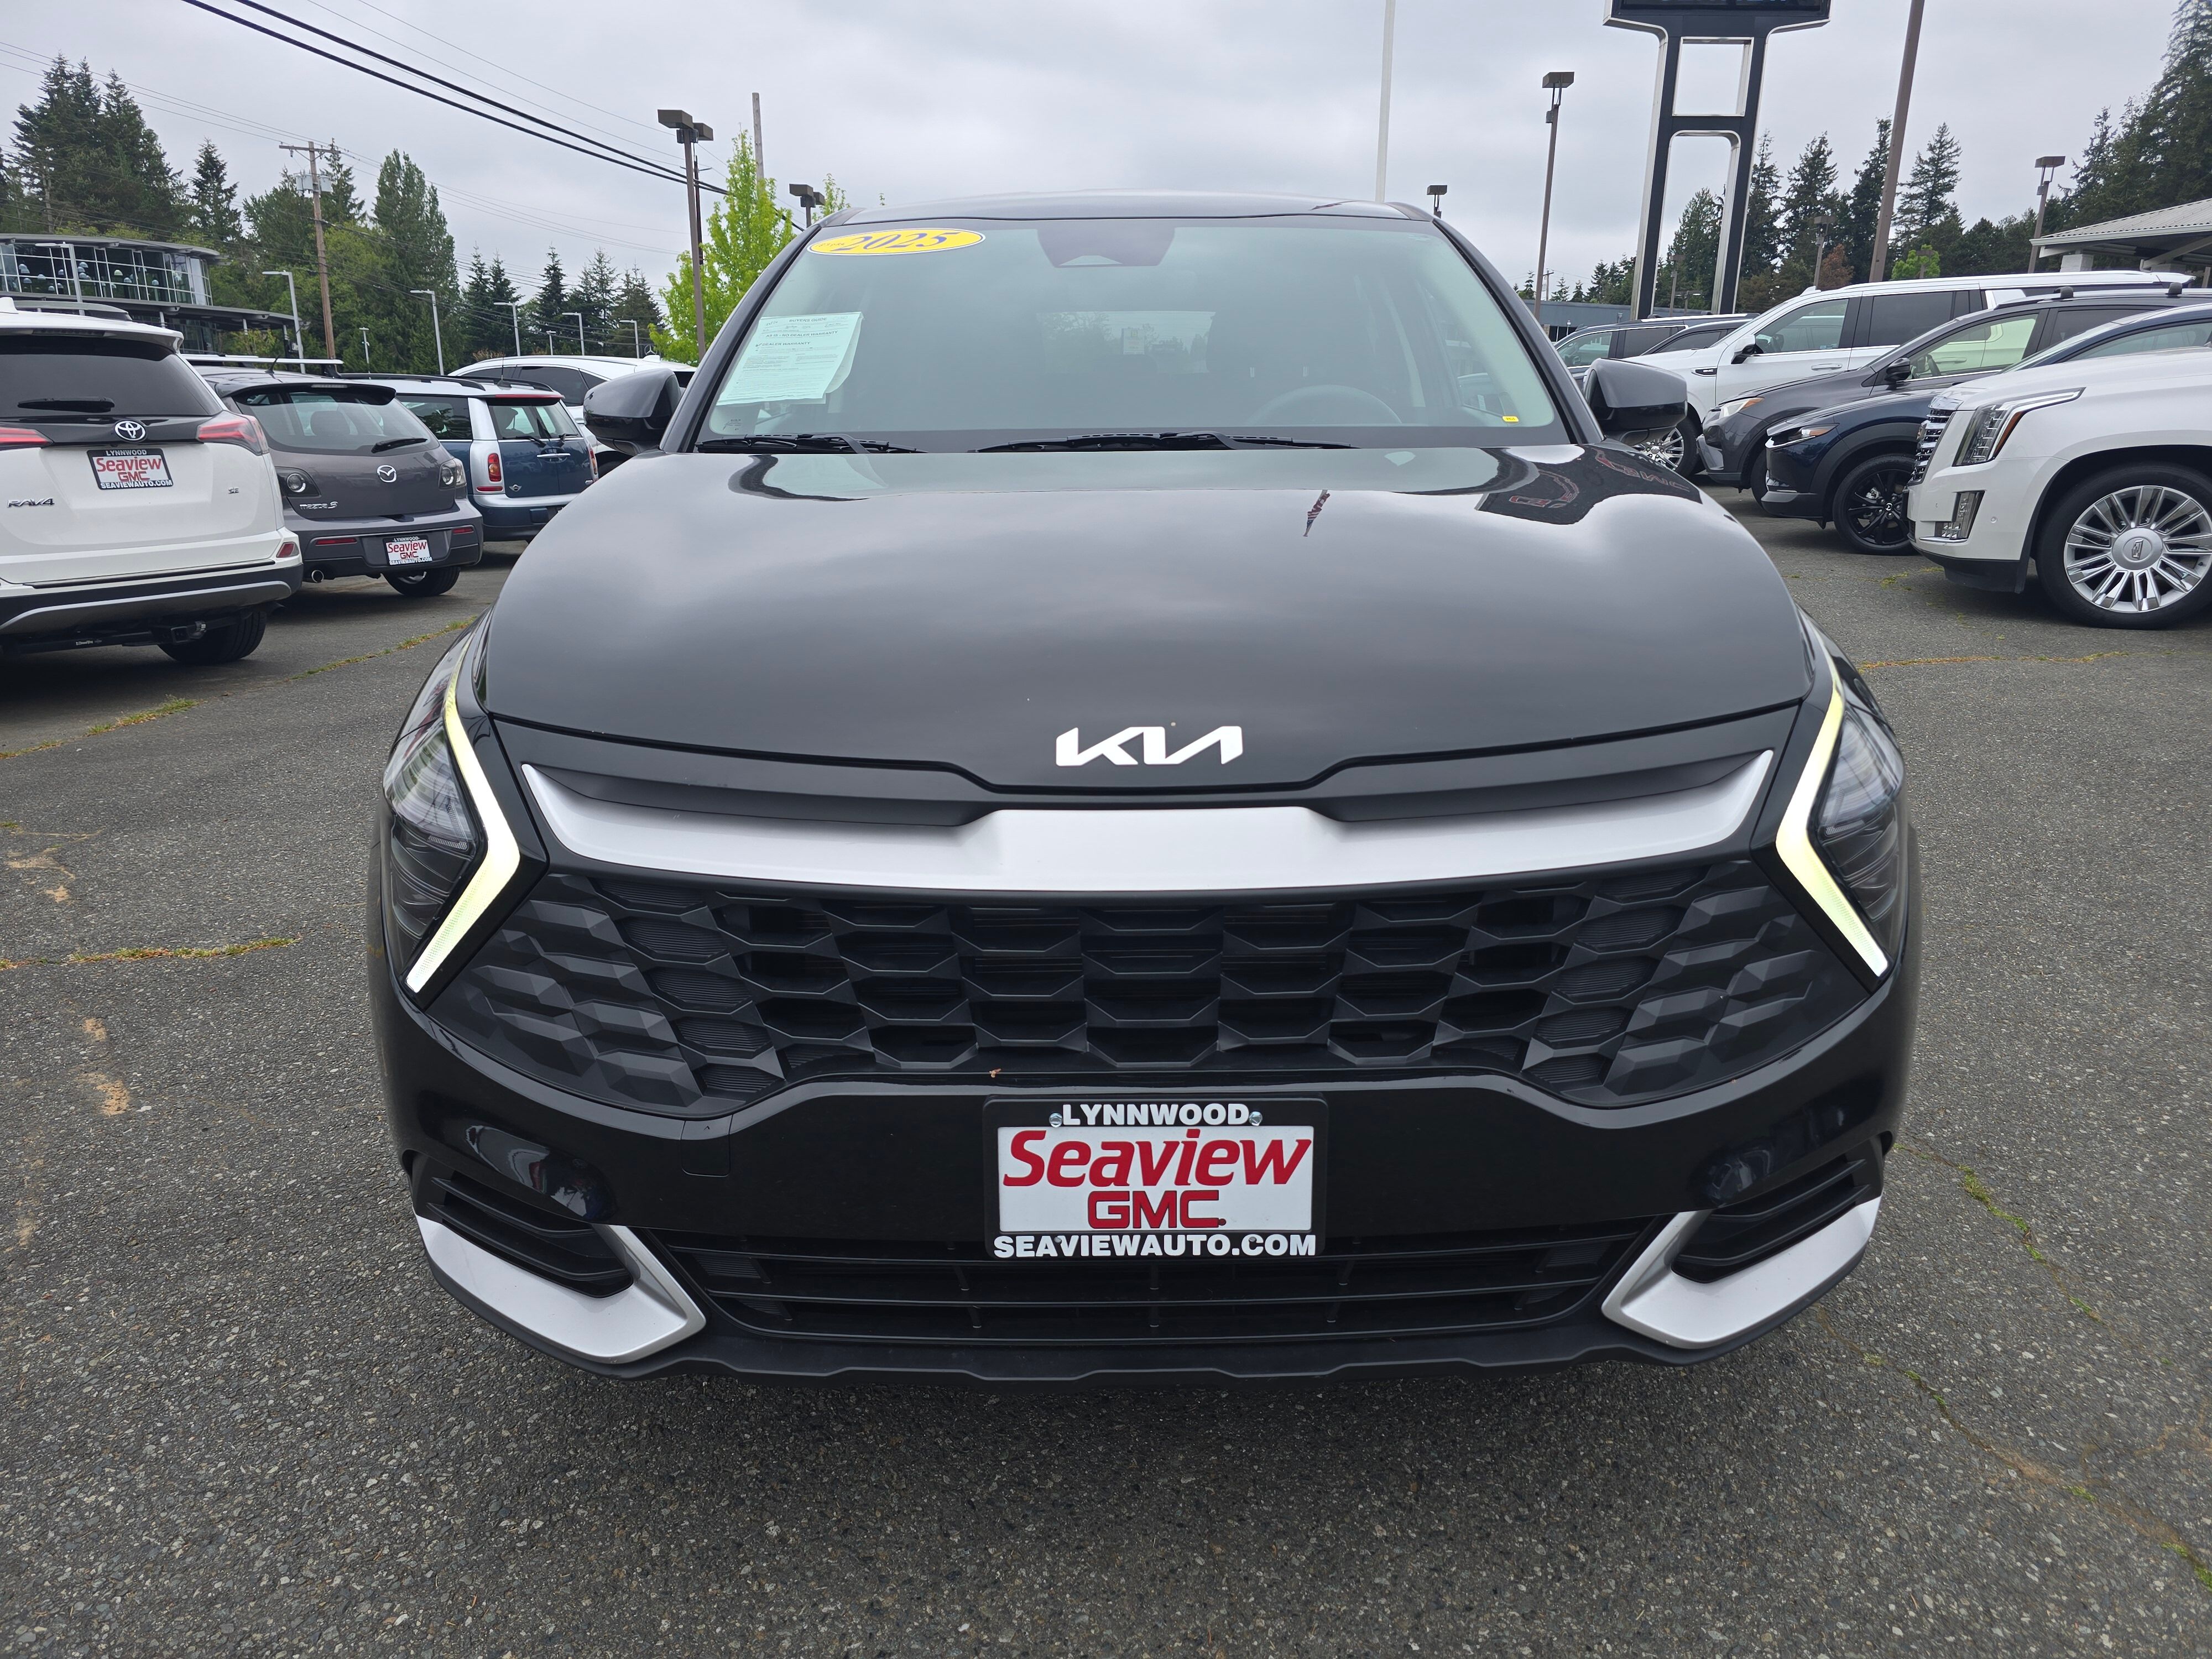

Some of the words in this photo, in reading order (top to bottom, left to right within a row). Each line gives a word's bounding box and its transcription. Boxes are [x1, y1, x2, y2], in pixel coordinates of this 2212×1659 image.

[830, 232, 961, 251] 2025
[96, 456, 162, 472] Seaview
[101, 479, 173, 489] SEAVIEWAUTO.COM
[118, 471, 150, 482] GMC
[7, 497, 55, 508] RAV4
[388, 541, 426, 552] Seaview
[1056, 726, 1243, 766] KIA
[1062, 1103, 1249, 1125] LYNNWOOD
[1003, 1128, 1312, 1187] Seaview
[1088, 1190, 1220, 1229] GMC
[994, 1234, 1316, 1258] SEAVIEWAUTO.COM
